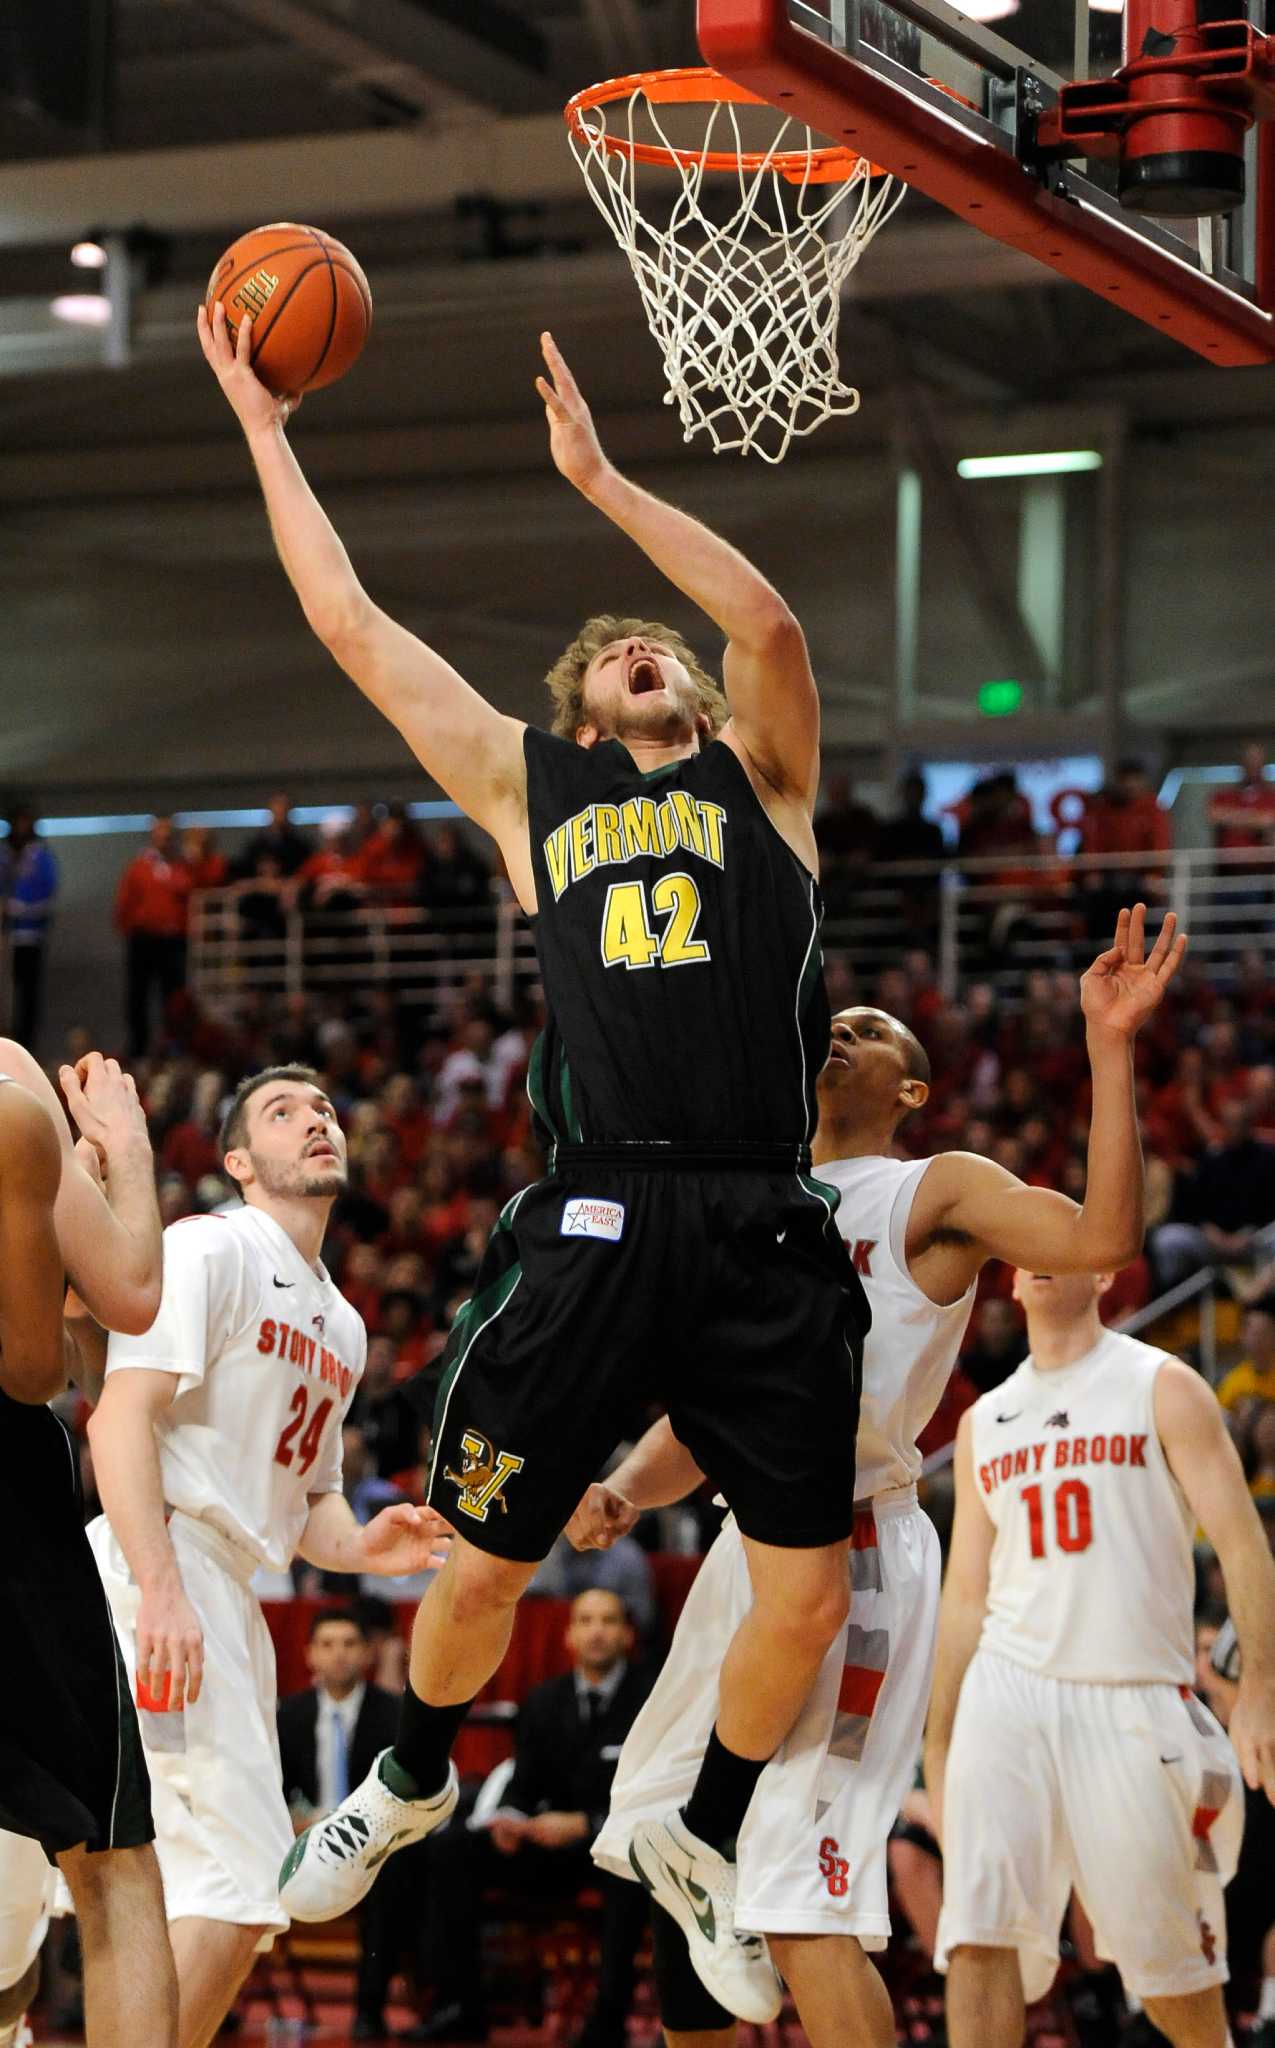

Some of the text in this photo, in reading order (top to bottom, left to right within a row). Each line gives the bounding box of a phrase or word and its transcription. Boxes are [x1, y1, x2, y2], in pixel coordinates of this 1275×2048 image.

[232, 268, 280, 324] THE
[543, 790, 728, 904] VERMONT
[601, 871, 712, 971] 42
[576, 1202, 623, 1218] AMERICA
[591, 1215, 616, 1227] EAST
[256, 1318, 316, 1376] STONY
[274, 1384, 335, 1478] 24
[979, 1434, 1148, 1495] STONY BROOK
[1020, 1479, 1094, 1560] 10
